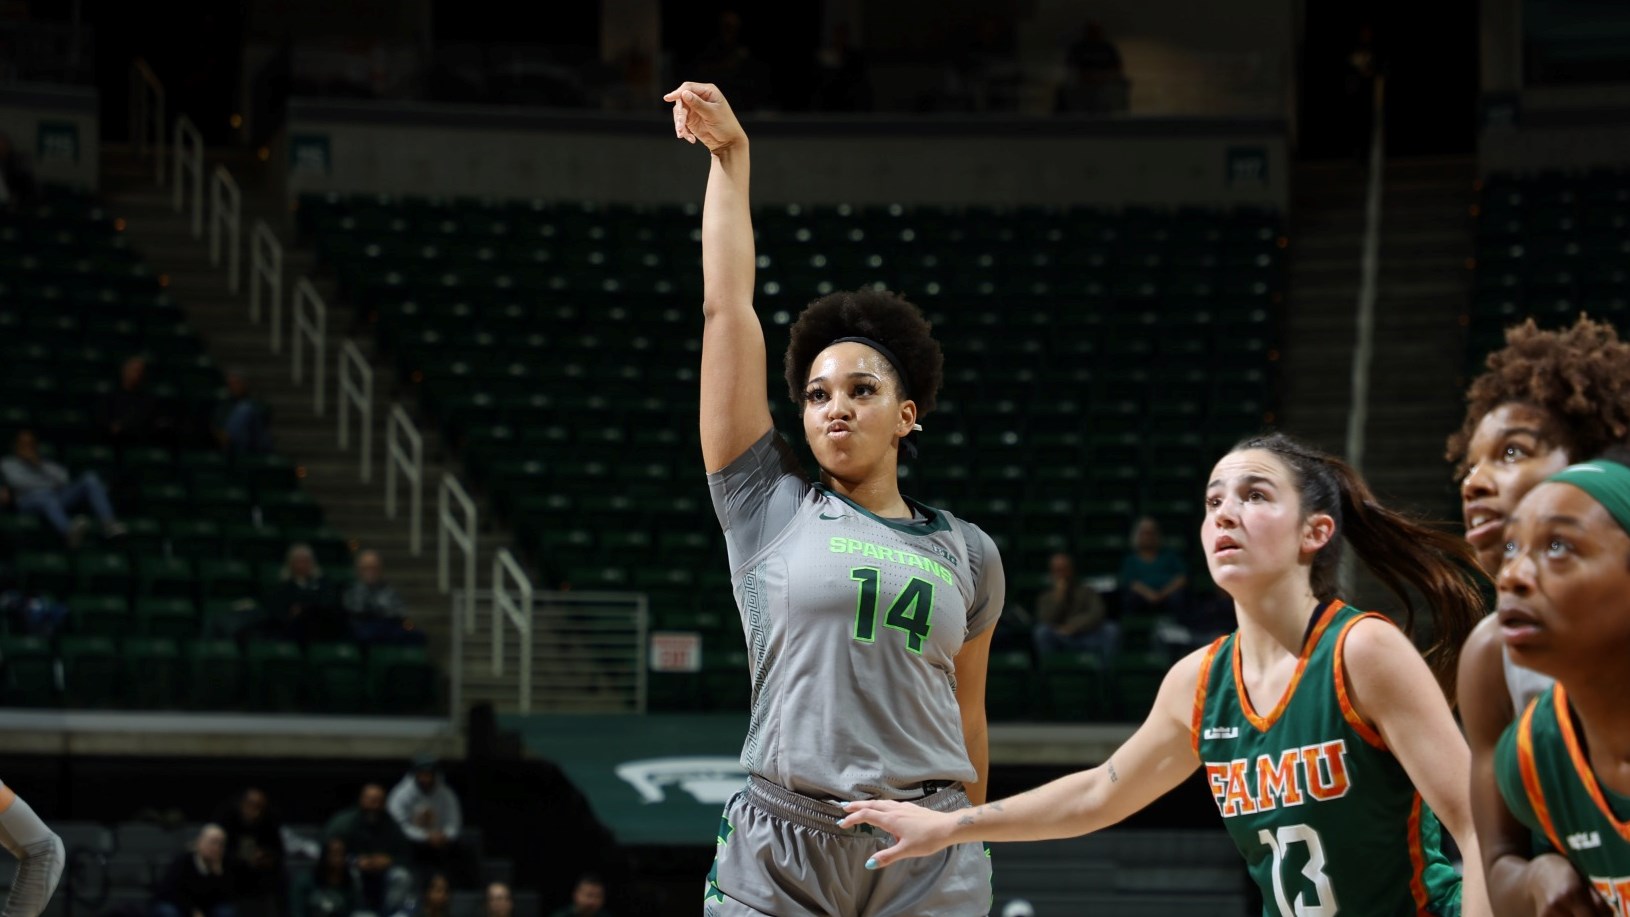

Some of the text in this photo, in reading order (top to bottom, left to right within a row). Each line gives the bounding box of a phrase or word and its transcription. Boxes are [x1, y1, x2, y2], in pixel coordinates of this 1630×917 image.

[830, 536, 953, 586] SPARTANS
[850, 565, 935, 656] 14
[1205, 739, 1350, 818] FAMU
[1258, 823, 1339, 917] 13
